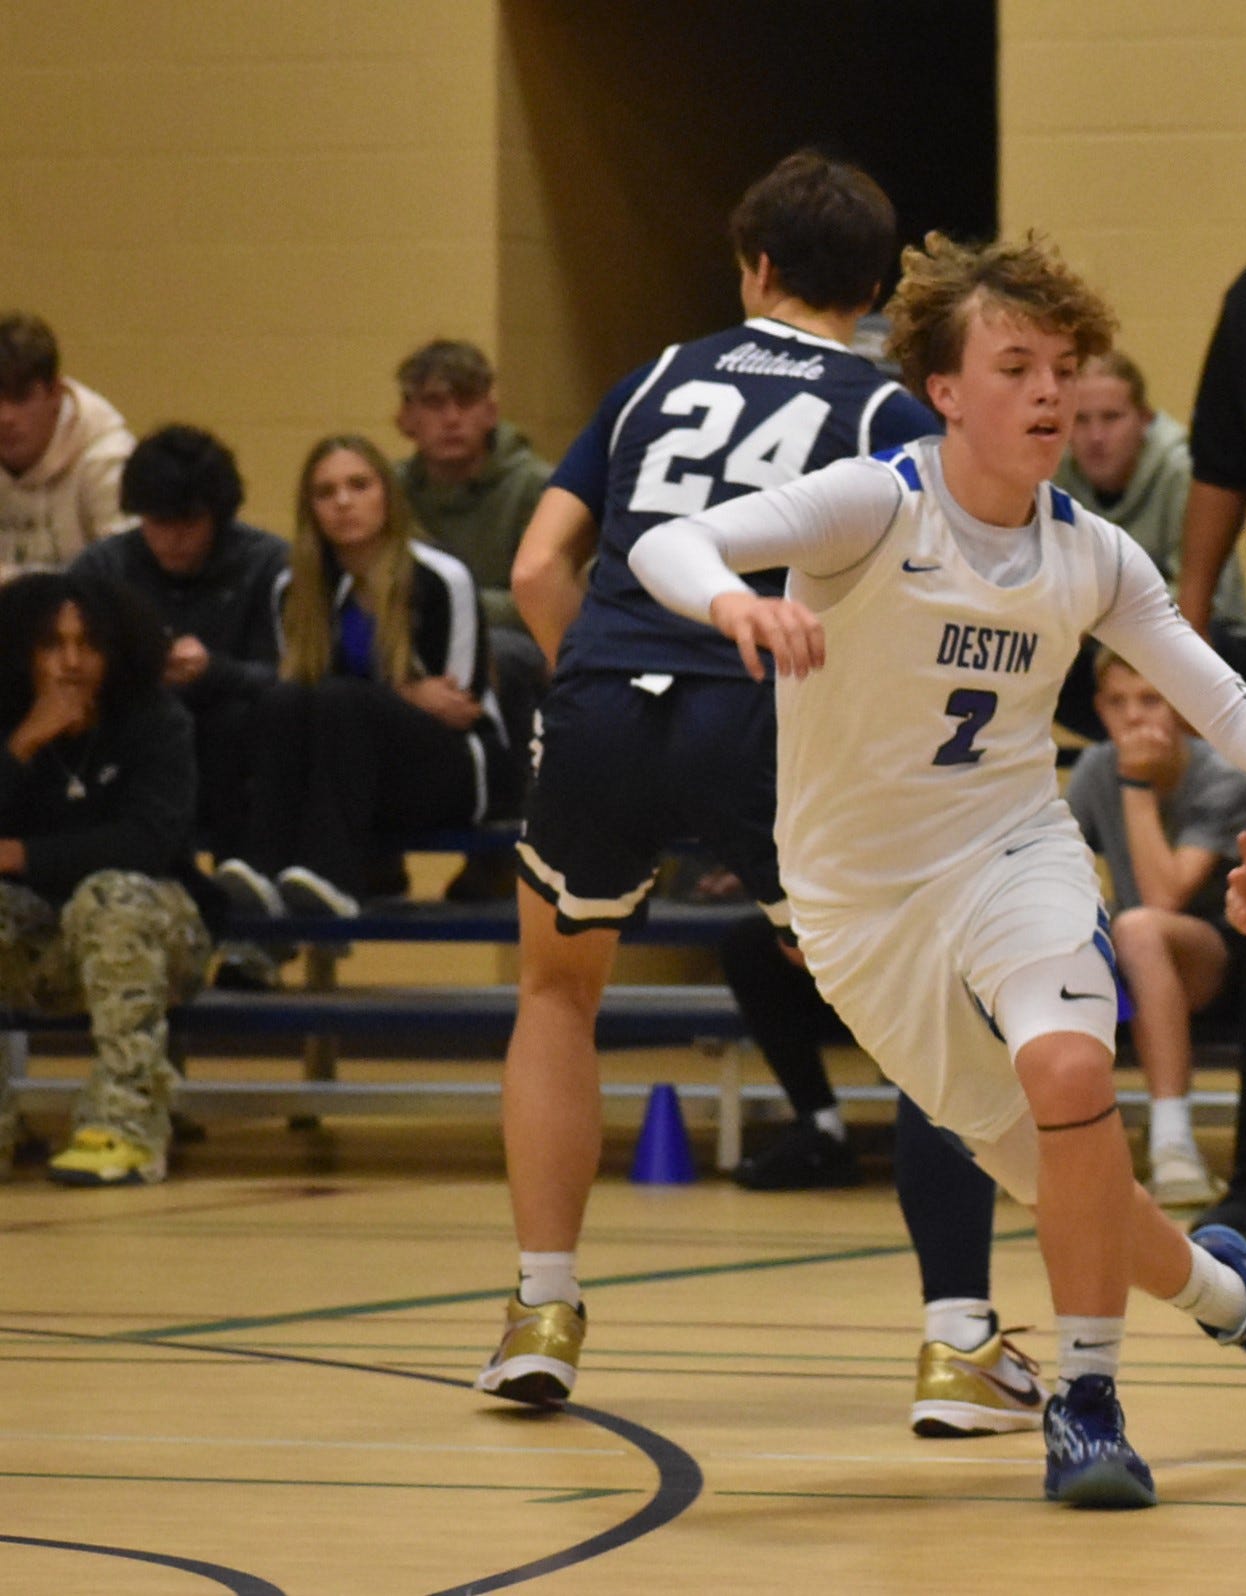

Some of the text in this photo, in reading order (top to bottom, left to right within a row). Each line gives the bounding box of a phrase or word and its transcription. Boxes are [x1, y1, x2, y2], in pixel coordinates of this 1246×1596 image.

[628, 379, 831, 515] 24
[936, 623, 1038, 674] DESTIN
[931, 687, 998, 766] 2
